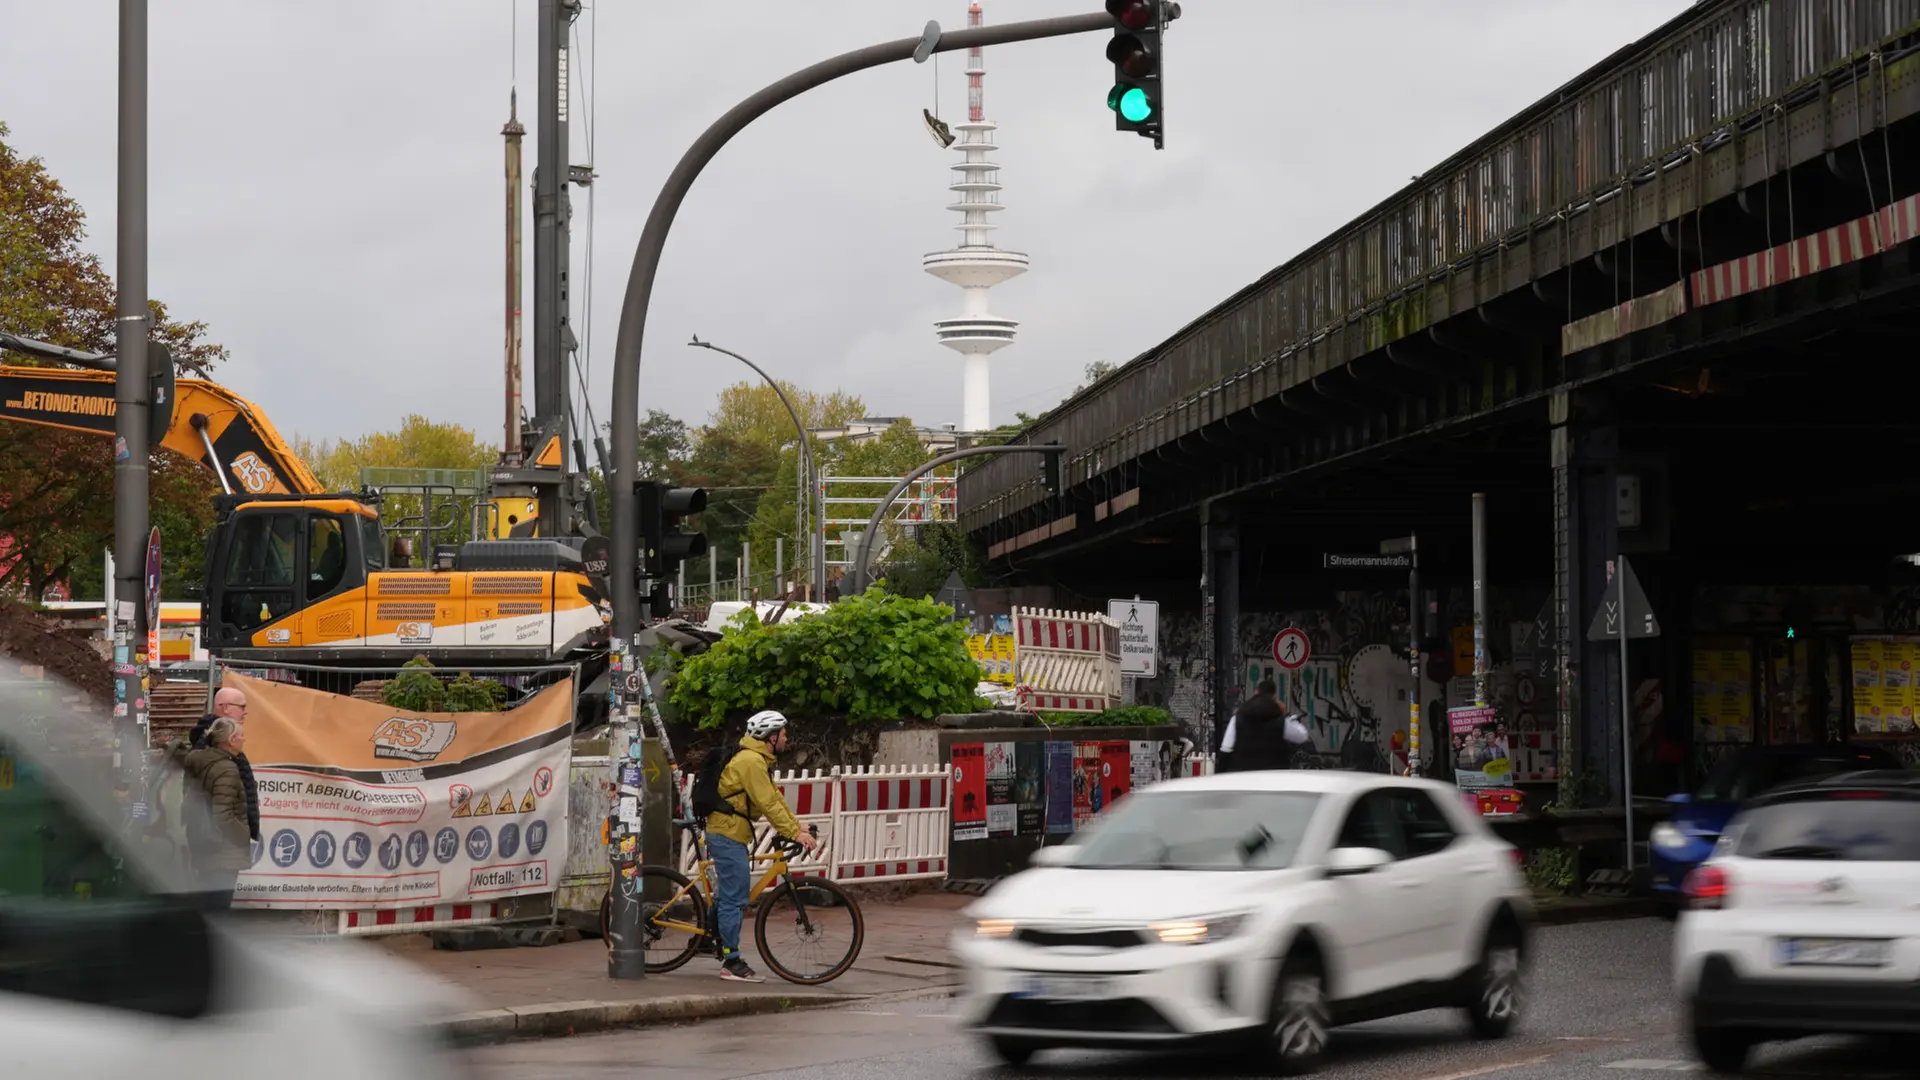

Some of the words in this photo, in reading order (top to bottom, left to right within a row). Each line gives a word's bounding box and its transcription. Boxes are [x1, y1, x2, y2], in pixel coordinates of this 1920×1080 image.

[585, 560, 607, 573] USP
[1330, 555, 1410, 566] Stresemannstraße
[1122, 622, 1143, 634] Richtung
[1120, 633, 1149, 643] chulterblatt
[305, 783, 422, 804] ABBRUCHARBEITEN
[263, 797, 298, 810] Zugang
[301, 798, 313, 808] für
[316, 800, 340, 810] nicht
[474, 871, 514, 886] Notfall:
[522, 867, 541, 881] 112
[282, 884, 315, 892] Baustelle
[352, 884, 372, 893] Eltern
